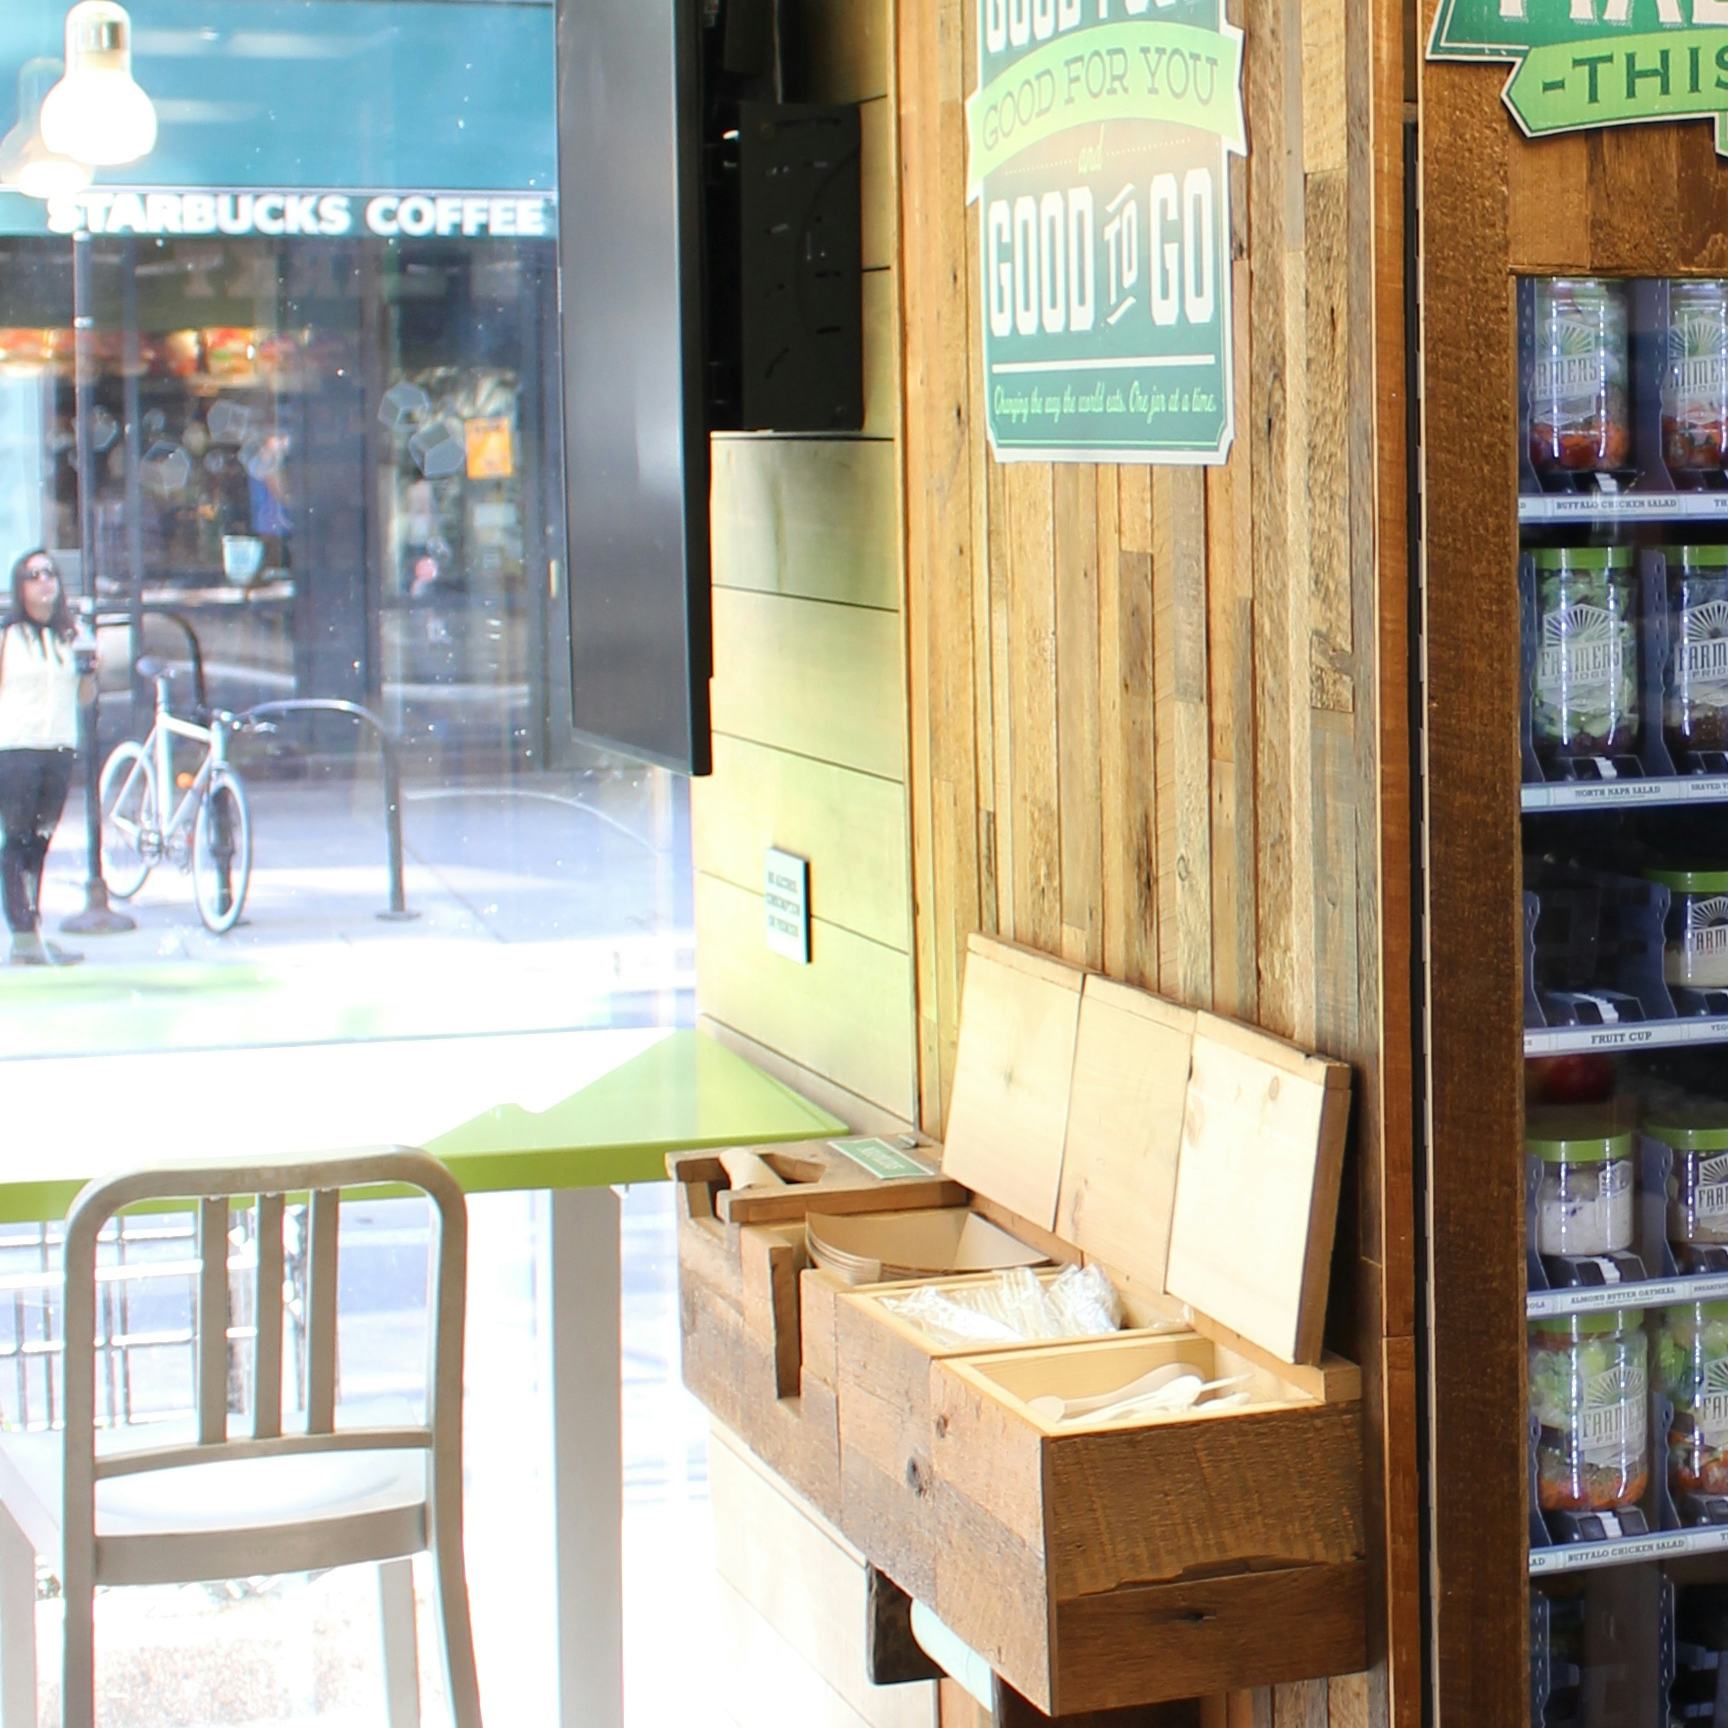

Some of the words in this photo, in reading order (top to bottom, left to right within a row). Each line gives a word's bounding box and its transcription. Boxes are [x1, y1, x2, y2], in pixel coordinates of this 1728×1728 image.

[982, 68, 1055, 151] GOOD
[1064, 47, 1129, 105] FOR
[1139, 46, 1218, 106] YOU
[46, 192, 351, 235] STARBUCKS
[365, 195, 547, 236] COFFEE
[989, 186, 1094, 338] GOOD
[1104, 197, 1139, 307] TO
[1150, 168, 1215, 326] GO
[1591, 1033, 1627, 1044] FRUIT
[1629, 1031, 1652, 1042] CUP
[1567, 1549, 1609, 1563] BUFFALO
[1611, 1544, 1654, 1556] CHICKEN
[1656, 1539, 1685, 1551] SALAD
